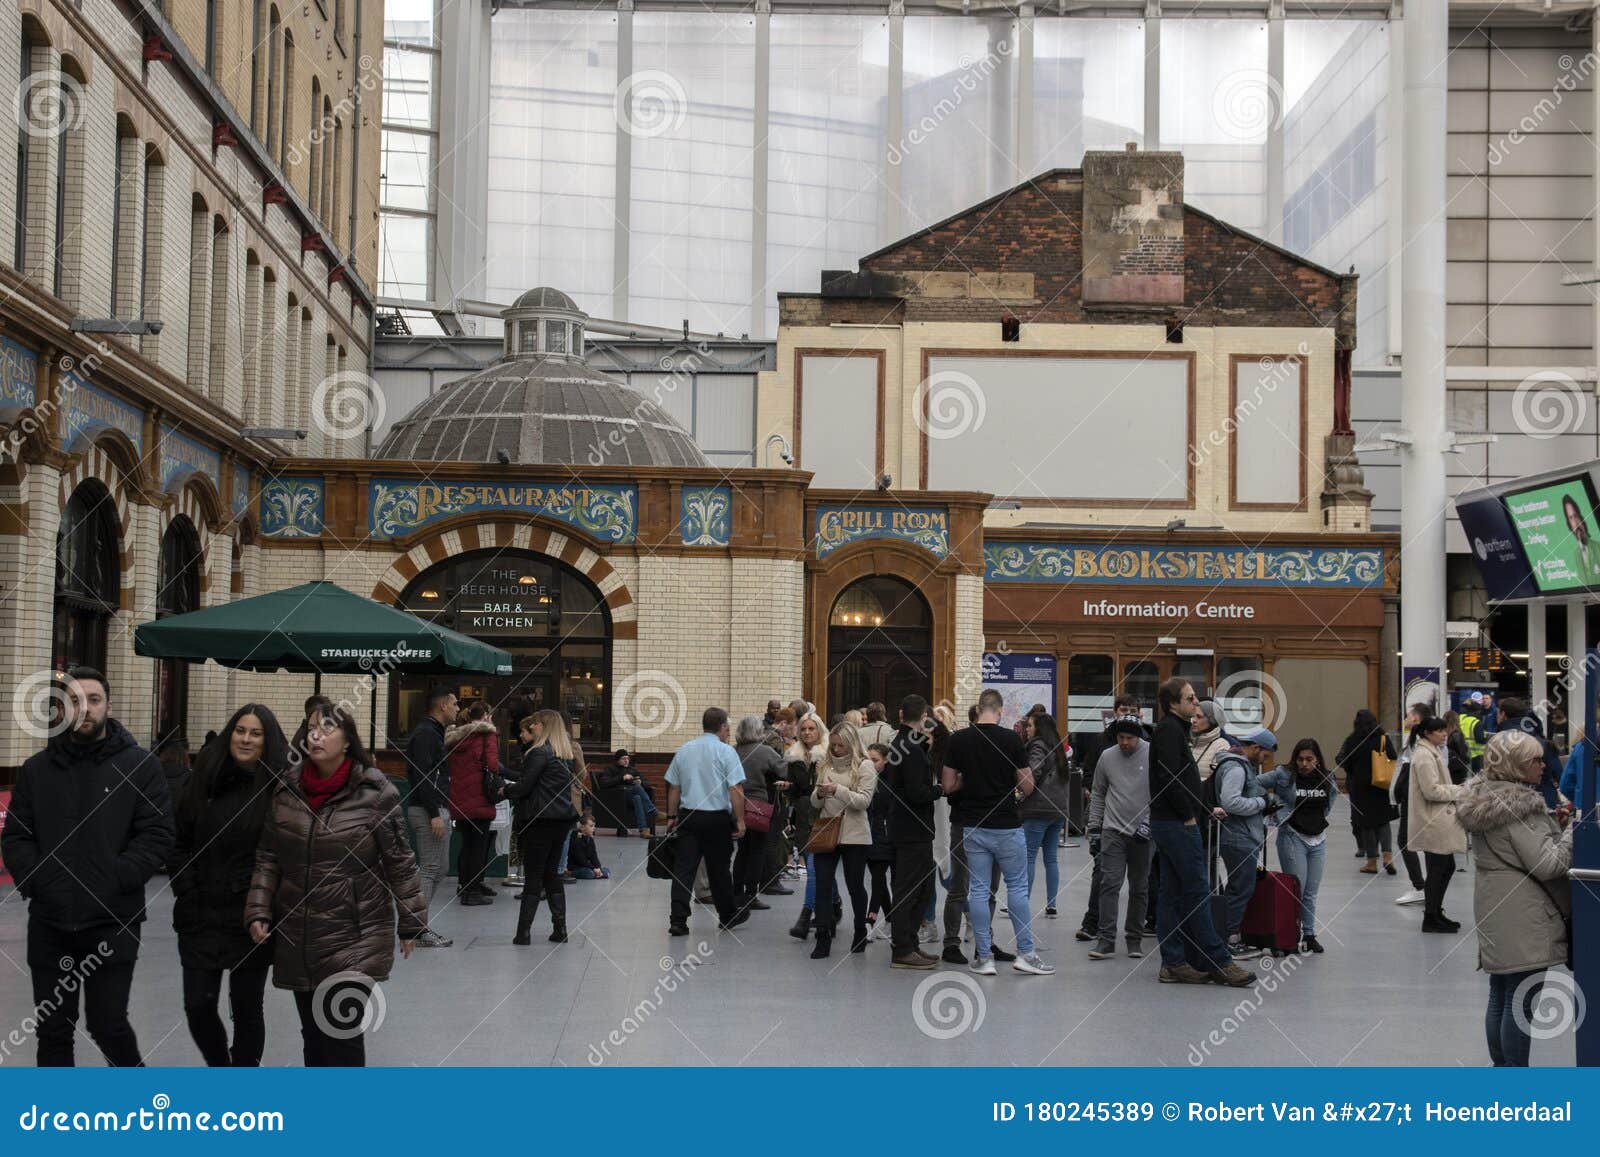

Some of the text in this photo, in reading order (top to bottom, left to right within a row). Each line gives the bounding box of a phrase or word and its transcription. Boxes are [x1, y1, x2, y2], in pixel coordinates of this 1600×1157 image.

[417, 484, 594, 521] RESTAURANT
[819, 510, 947, 543] GRILL ROOM
[1073, 549, 1278, 580] BOOKSTALL
[491, 569, 518, 580] THE
[460, 585, 547, 596] BEER HOUSE
[484, 603, 523, 613] BAR &
[1083, 599, 1255, 619] Information Centre
[473, 617, 533, 628] KITCHEN
[321, 649, 432, 658] STARBUCKS COFFEE
